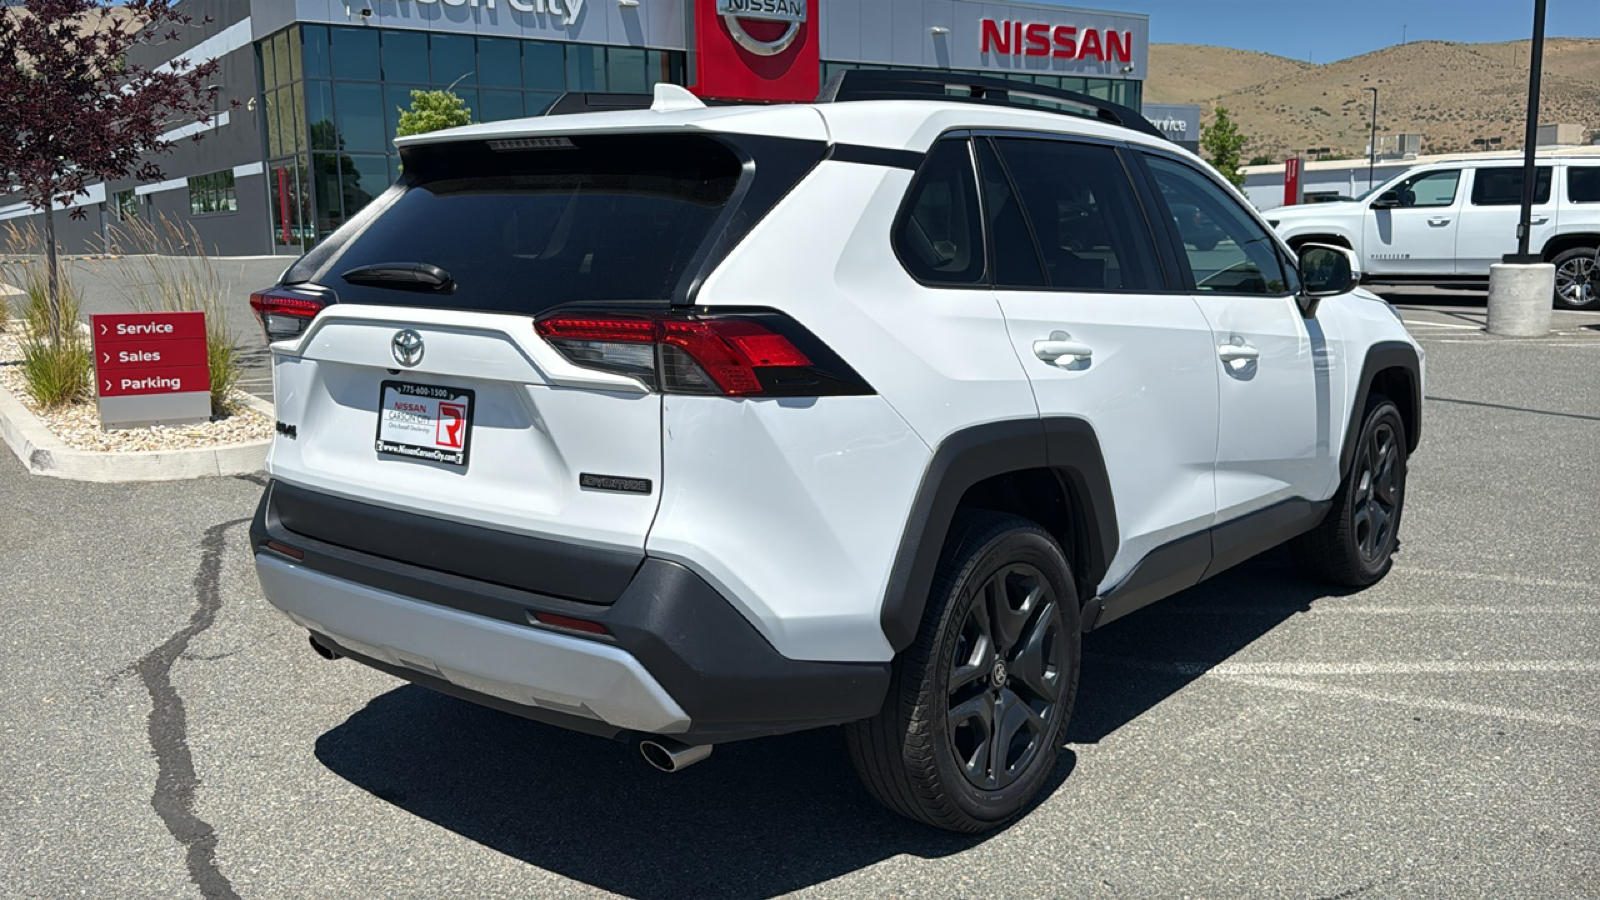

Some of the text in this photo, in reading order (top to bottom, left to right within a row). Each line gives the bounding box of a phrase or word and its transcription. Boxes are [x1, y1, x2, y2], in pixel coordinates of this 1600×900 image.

[728, 0, 801, 16] NISSAN
[981, 19, 1132, 63] NISSAN
[116, 321, 174, 335] Service
[119, 350, 161, 363] Sales
[120, 375, 181, 390] Parking
[402, 385, 447, 397] 775-600-1500
[394, 402, 426, 413] NISSAN
[389, 411, 415, 422] CARSON
